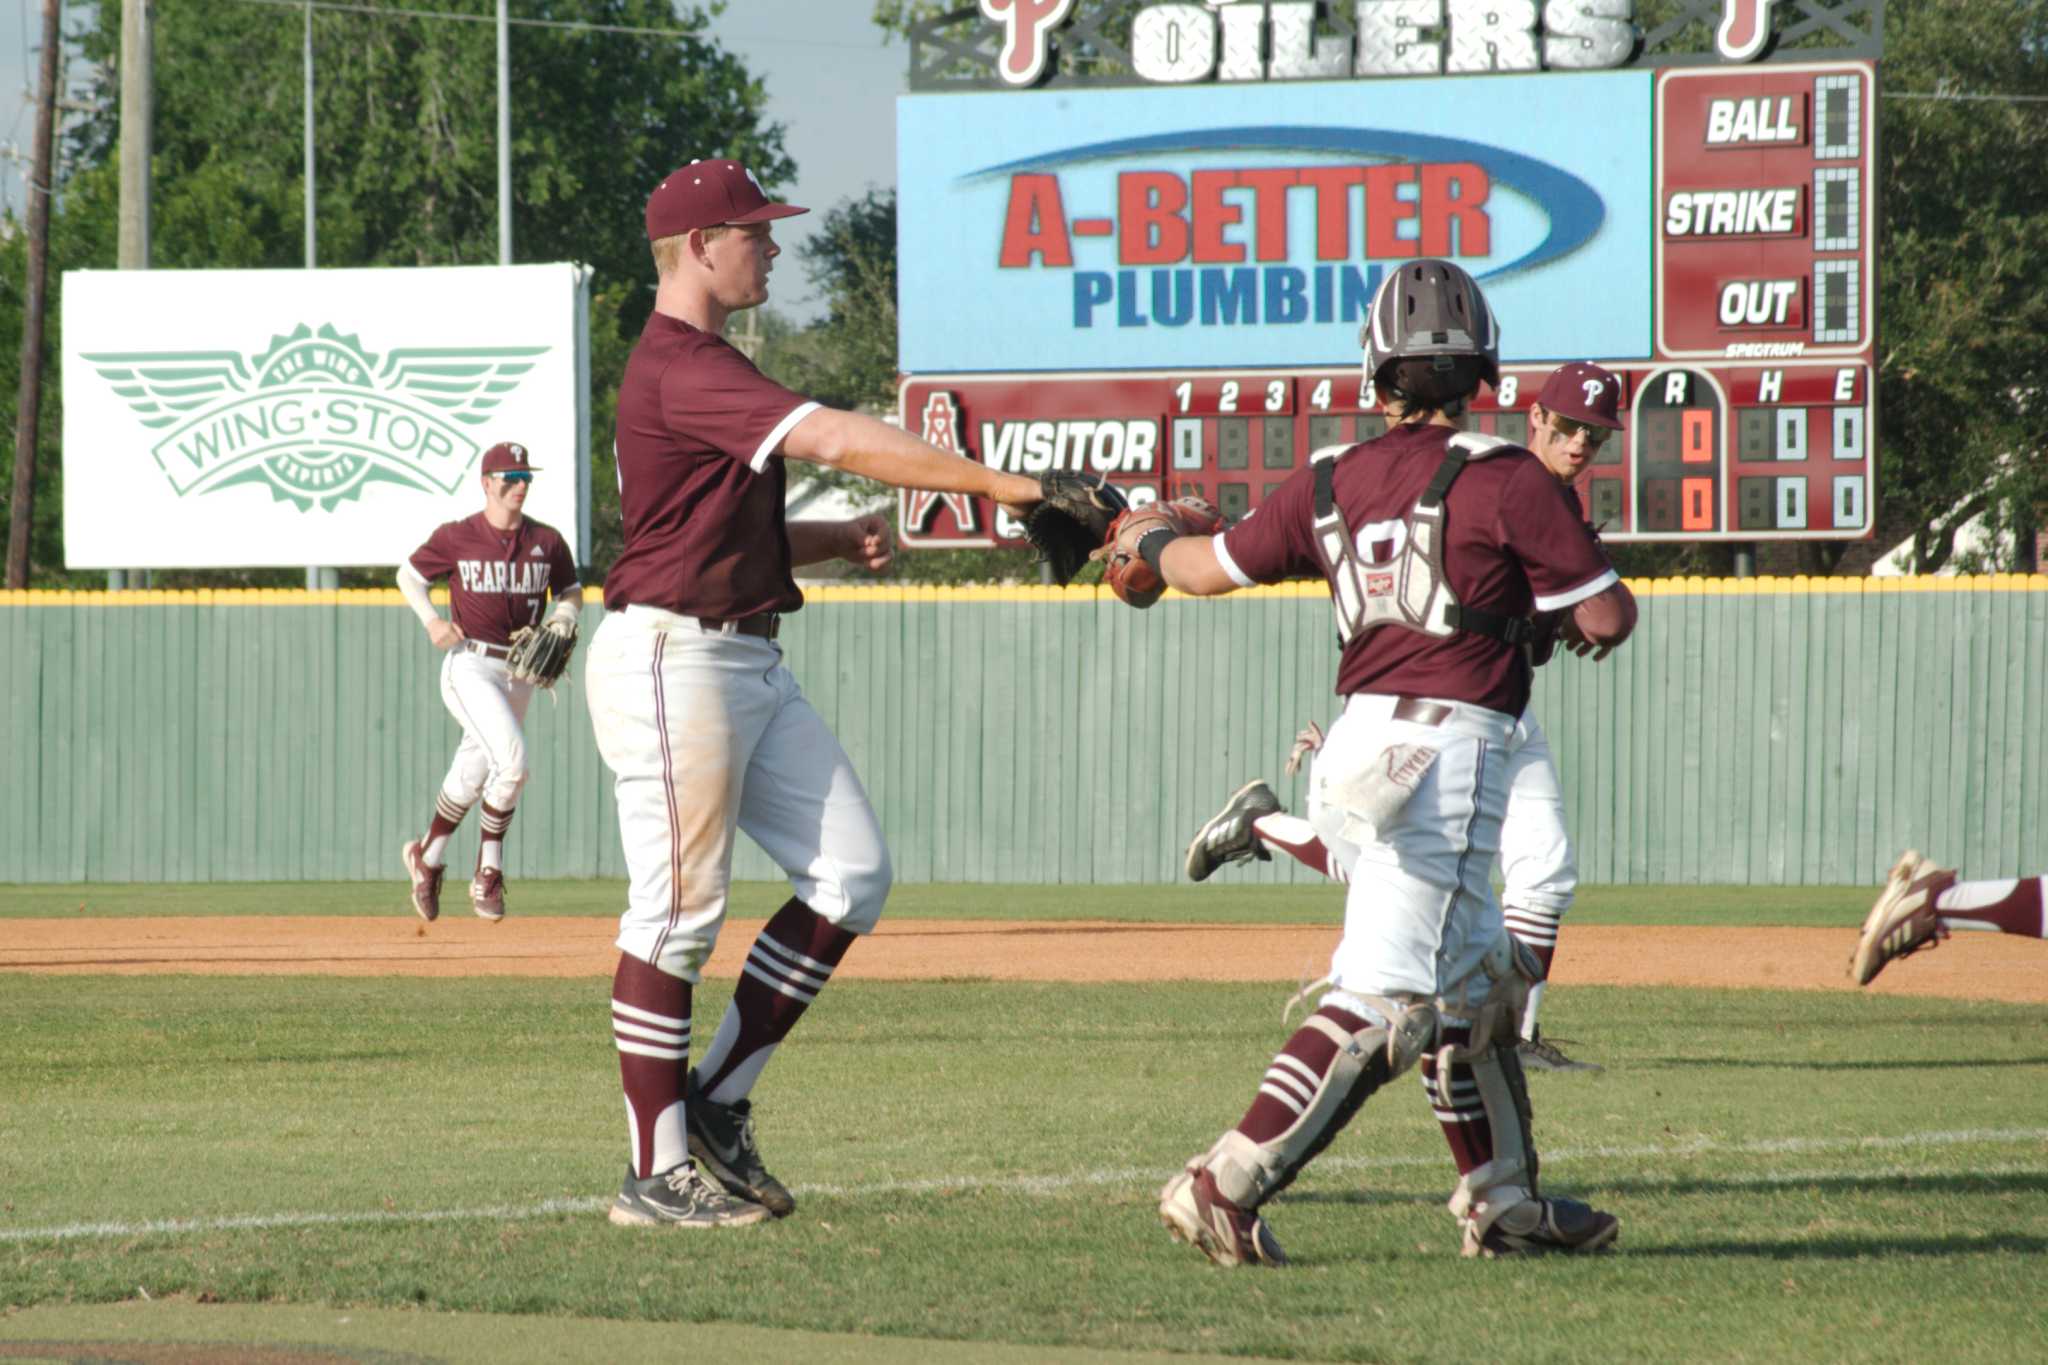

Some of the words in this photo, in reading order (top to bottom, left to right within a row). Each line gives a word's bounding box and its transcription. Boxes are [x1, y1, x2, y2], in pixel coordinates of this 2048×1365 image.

[1132, 0, 1634, 82] OILERS
[1706, 98, 1797, 143] BALL
[999, 162, 1490, 268] A-BETTER
[1666, 190, 1797, 236] STRIKE
[1073, 264, 1383, 327] PLUMBIN
[1719, 280, 1796, 325] OUT
[272, 352, 304, 382] THE
[312, 349, 359, 382] WING
[1726, 342, 1804, 358] SPECTRUM
[1176, 381, 1192, 411] 1
[1219, 381, 1240, 411] 2
[1265, 380, 1285, 411] 3
[1312, 379, 1332, 410] 4
[1498, 376, 1518, 407] 8
[1665, 372, 1687, 404] R
[1758, 370, 1783, 402] H
[1834, 368, 1855, 400] E
[1582, 379, 1604, 406] P
[981, 419, 1158, 473] VISITOR
[1173, 418, 1202, 469] 0
[1682, 409, 1713, 462] 0
[1777, 408, 1807, 461] 0
[1833, 407, 1864, 460] 0
[276, 455, 354, 486] EXPERTS
[1682, 477, 1713, 530] 0
[1777, 476, 1807, 529] 0
[1833, 475, 1864, 528] 0
[457, 560, 552, 594] PEARLAND
[527, 599, 540, 625] 7
